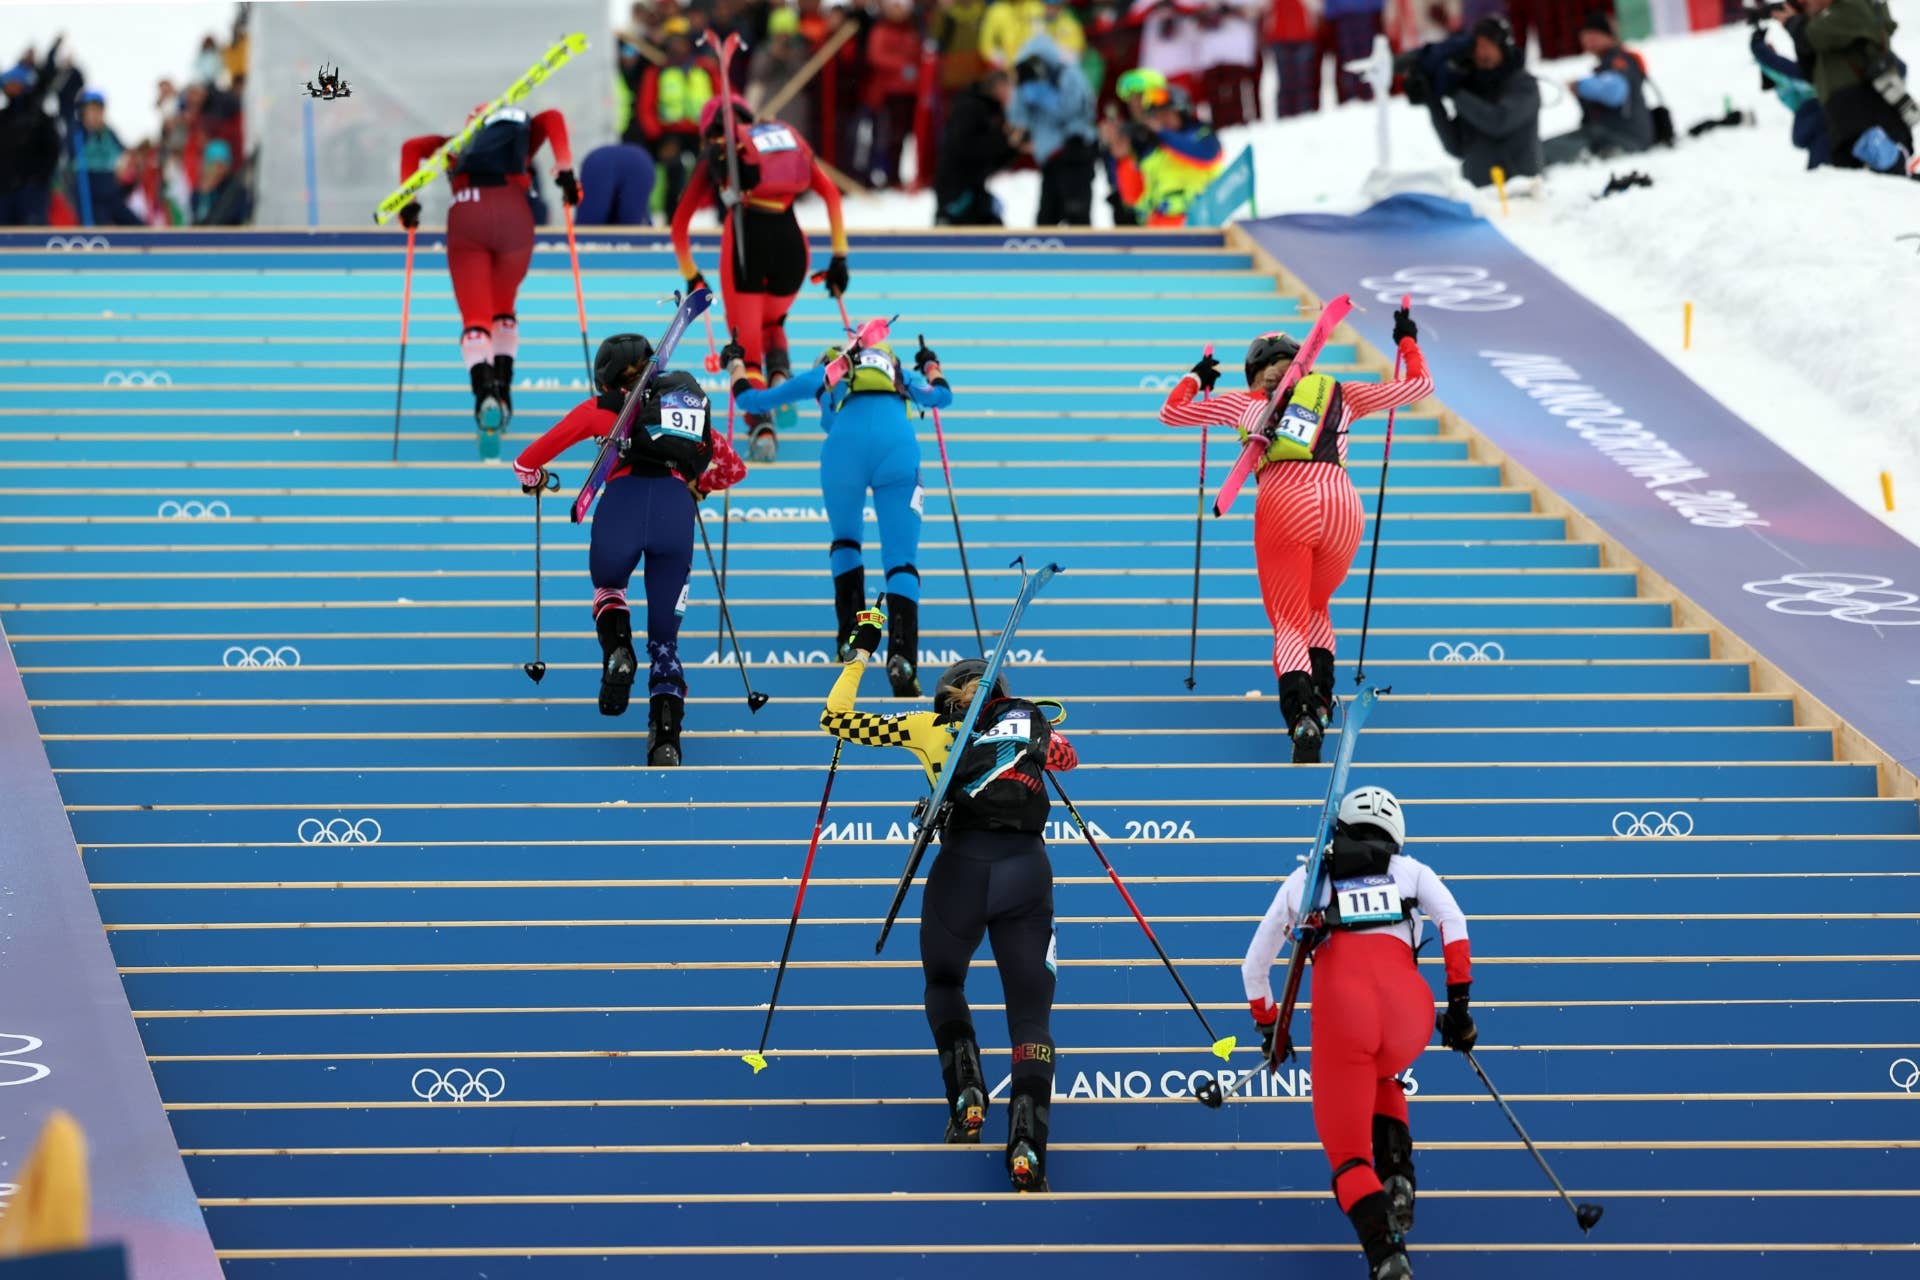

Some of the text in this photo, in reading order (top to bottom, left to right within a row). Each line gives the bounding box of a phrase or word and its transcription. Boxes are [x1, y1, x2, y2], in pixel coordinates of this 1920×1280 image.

[454, 187, 481, 203] UI
[671, 411, 697, 431] 9.1
[1279, 418, 1306, 437] 4.1
[1042, 820, 1112, 839] TINA
[1124, 820, 1196, 839] 2026
[1348, 891, 1390, 913] 11.1
